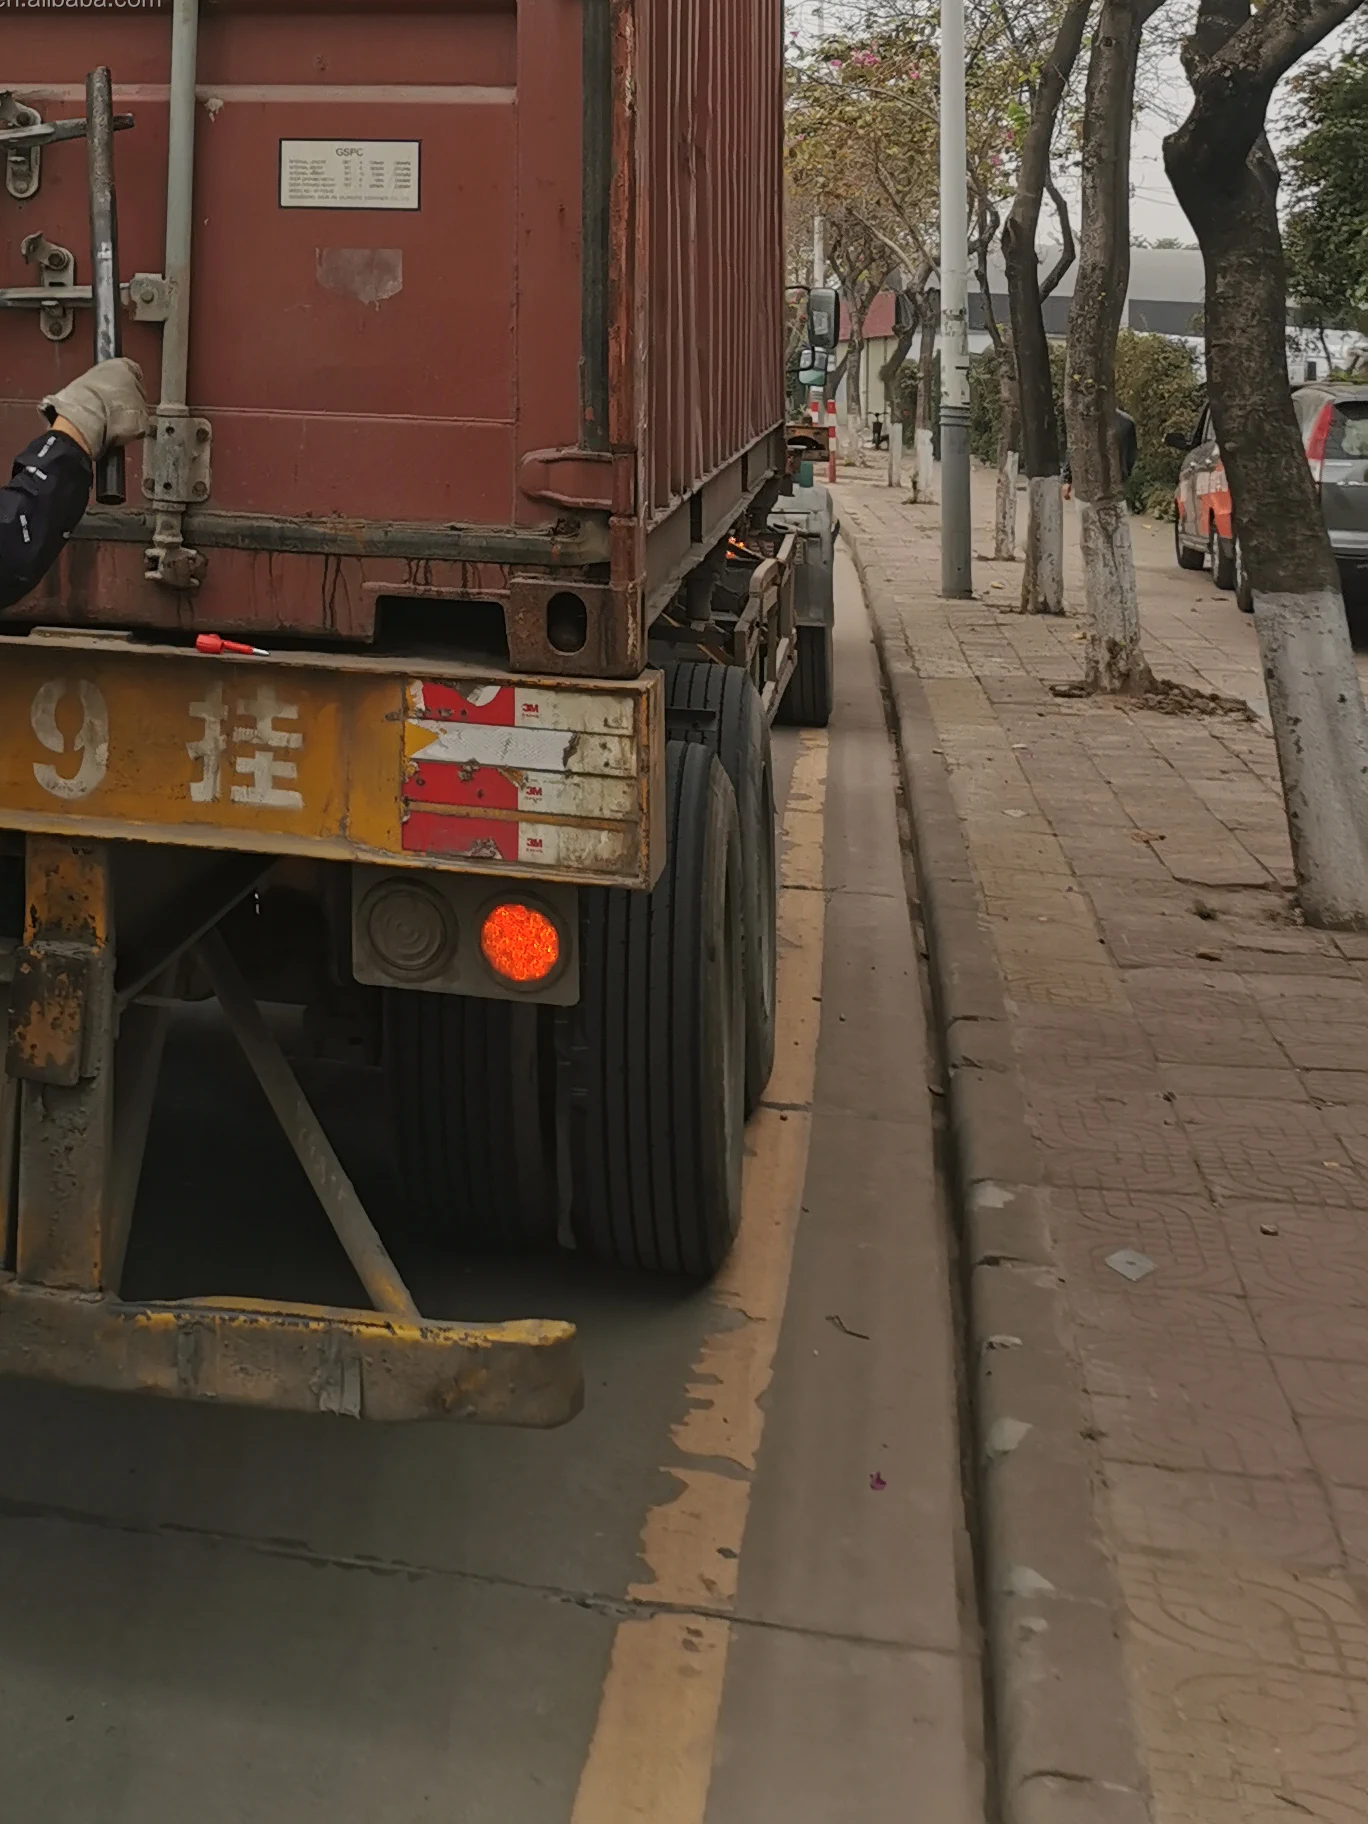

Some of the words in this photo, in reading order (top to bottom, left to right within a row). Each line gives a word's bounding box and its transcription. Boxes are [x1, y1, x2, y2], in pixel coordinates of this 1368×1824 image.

[522, 703, 539, 713] 3M
[525, 786, 543, 796] 3M
[526, 837, 543, 848] 3M
